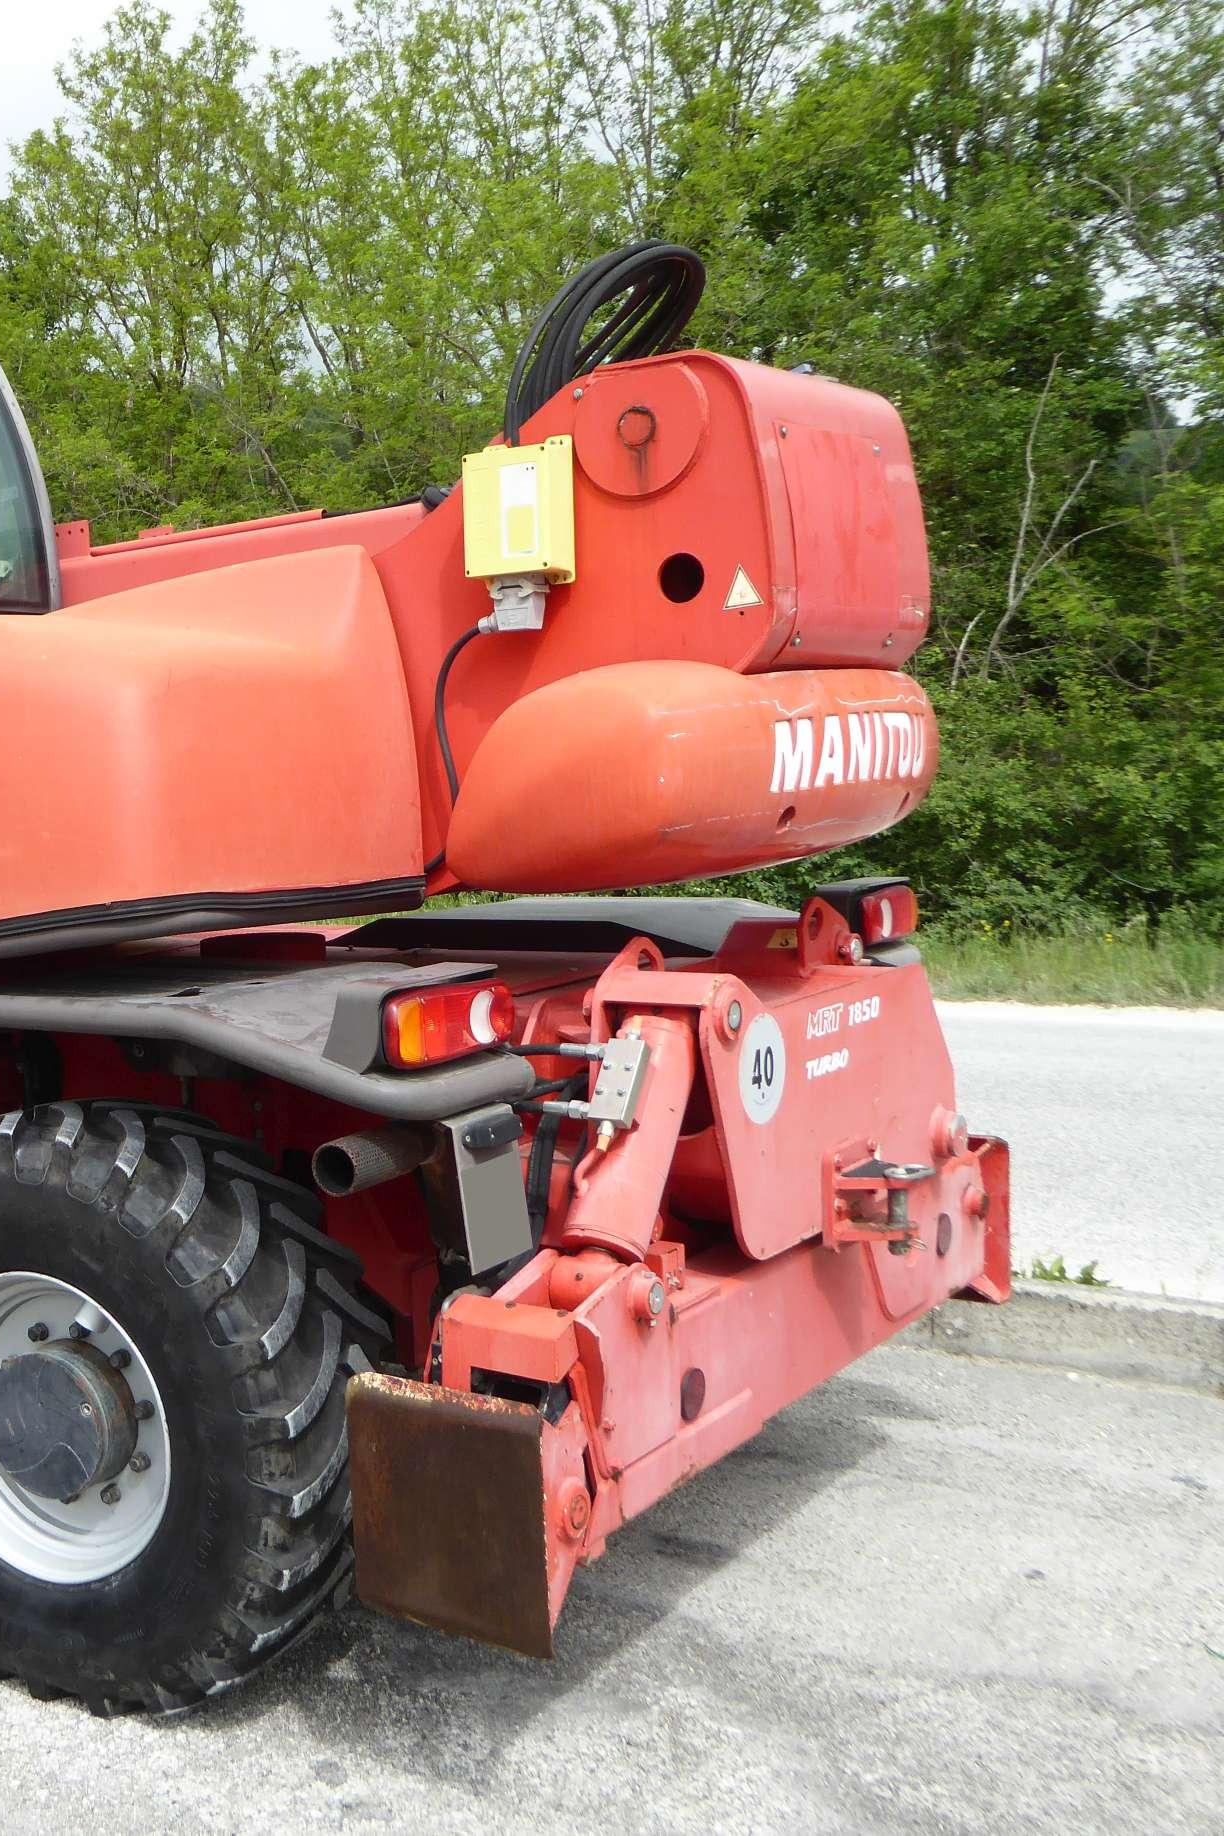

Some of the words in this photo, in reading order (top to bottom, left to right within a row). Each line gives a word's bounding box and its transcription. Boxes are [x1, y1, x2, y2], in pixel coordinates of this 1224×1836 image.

[769, 711, 925, 793] MANITOU
[806, 1002, 844, 1039] MRT
[848, 996, 881, 1026] 1850
[751, 1045, 774, 1090] 40
[805, 1048, 849, 1080] TURBO
